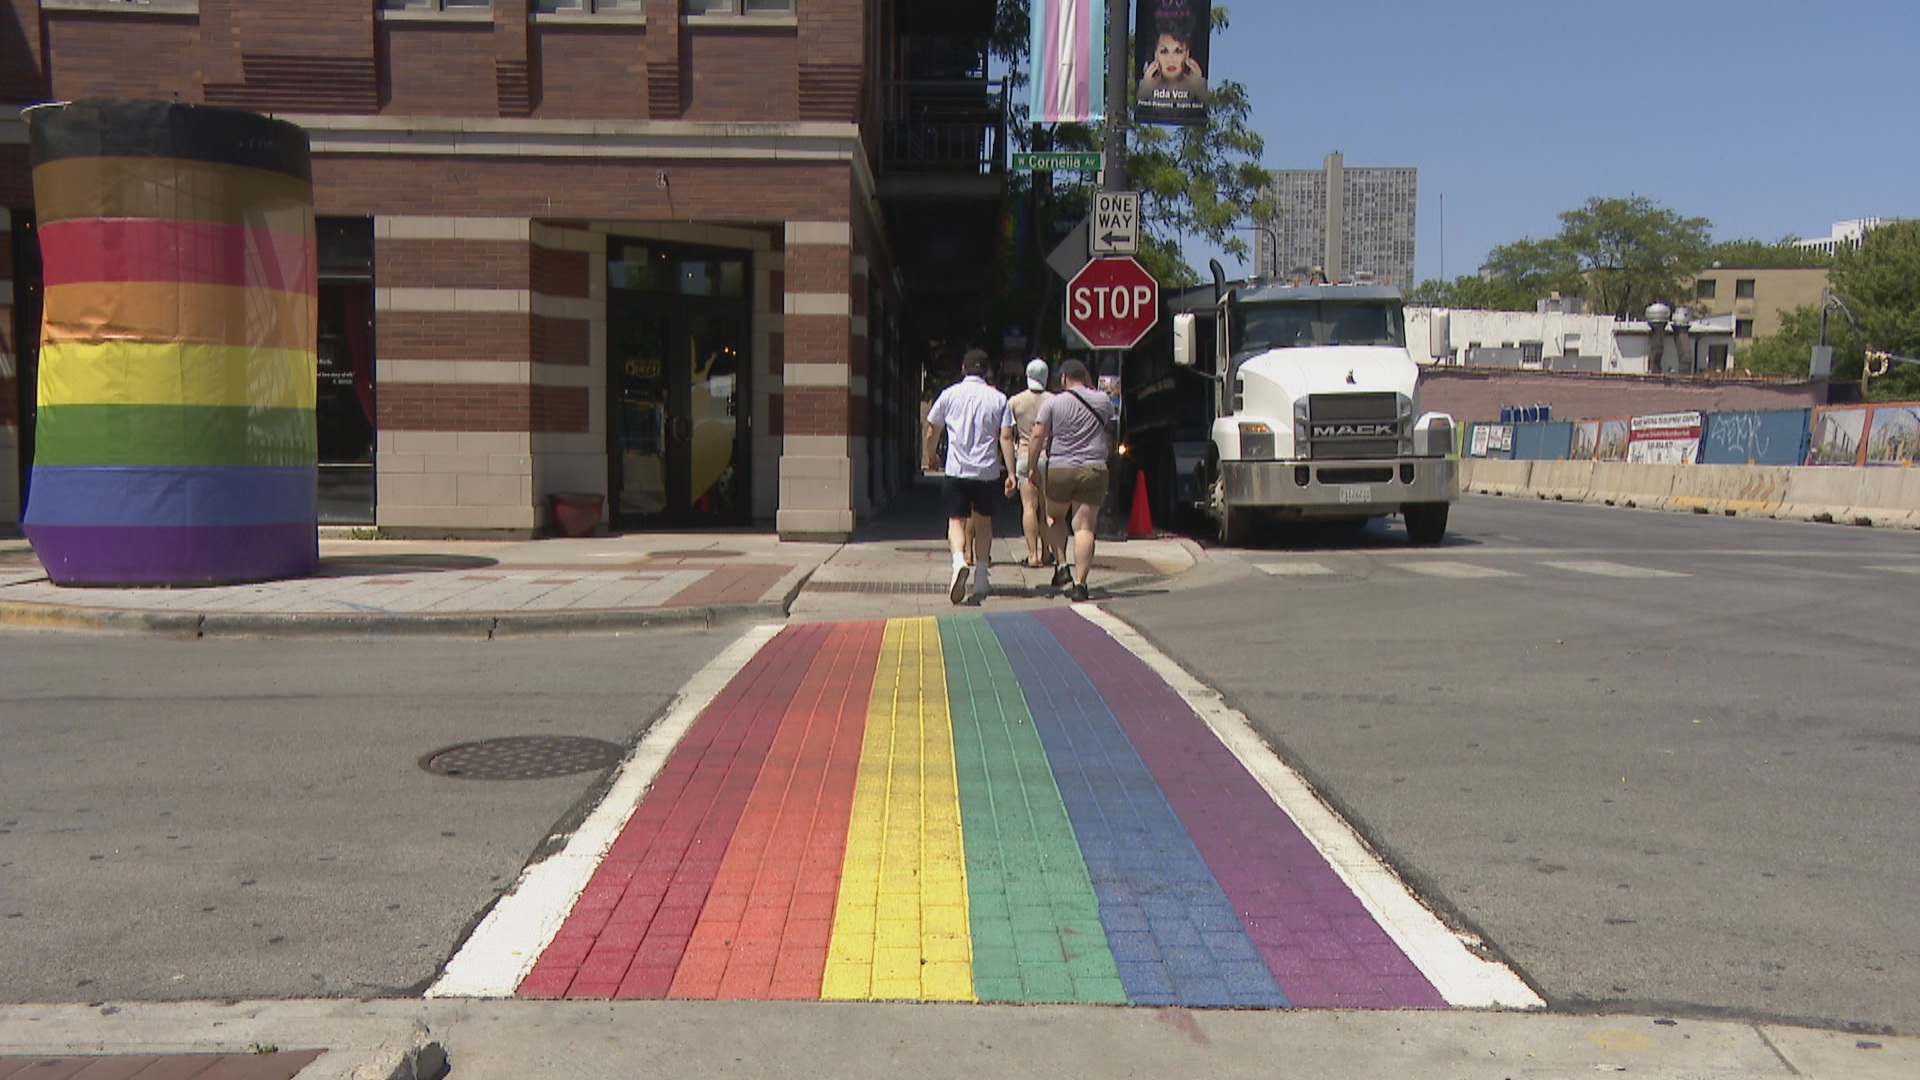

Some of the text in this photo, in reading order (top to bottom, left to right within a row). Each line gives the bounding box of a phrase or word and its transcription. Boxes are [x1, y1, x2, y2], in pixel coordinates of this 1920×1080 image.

[1172, 89, 1189, 99] Vox
[1018, 155, 1095, 168] W Cornelia Av
[1100, 196, 1133, 213] ONE
[1099, 212, 1133, 229] WAY
[1073, 285, 1152, 321] STOP
[1313, 424, 1394, 437] MACK
